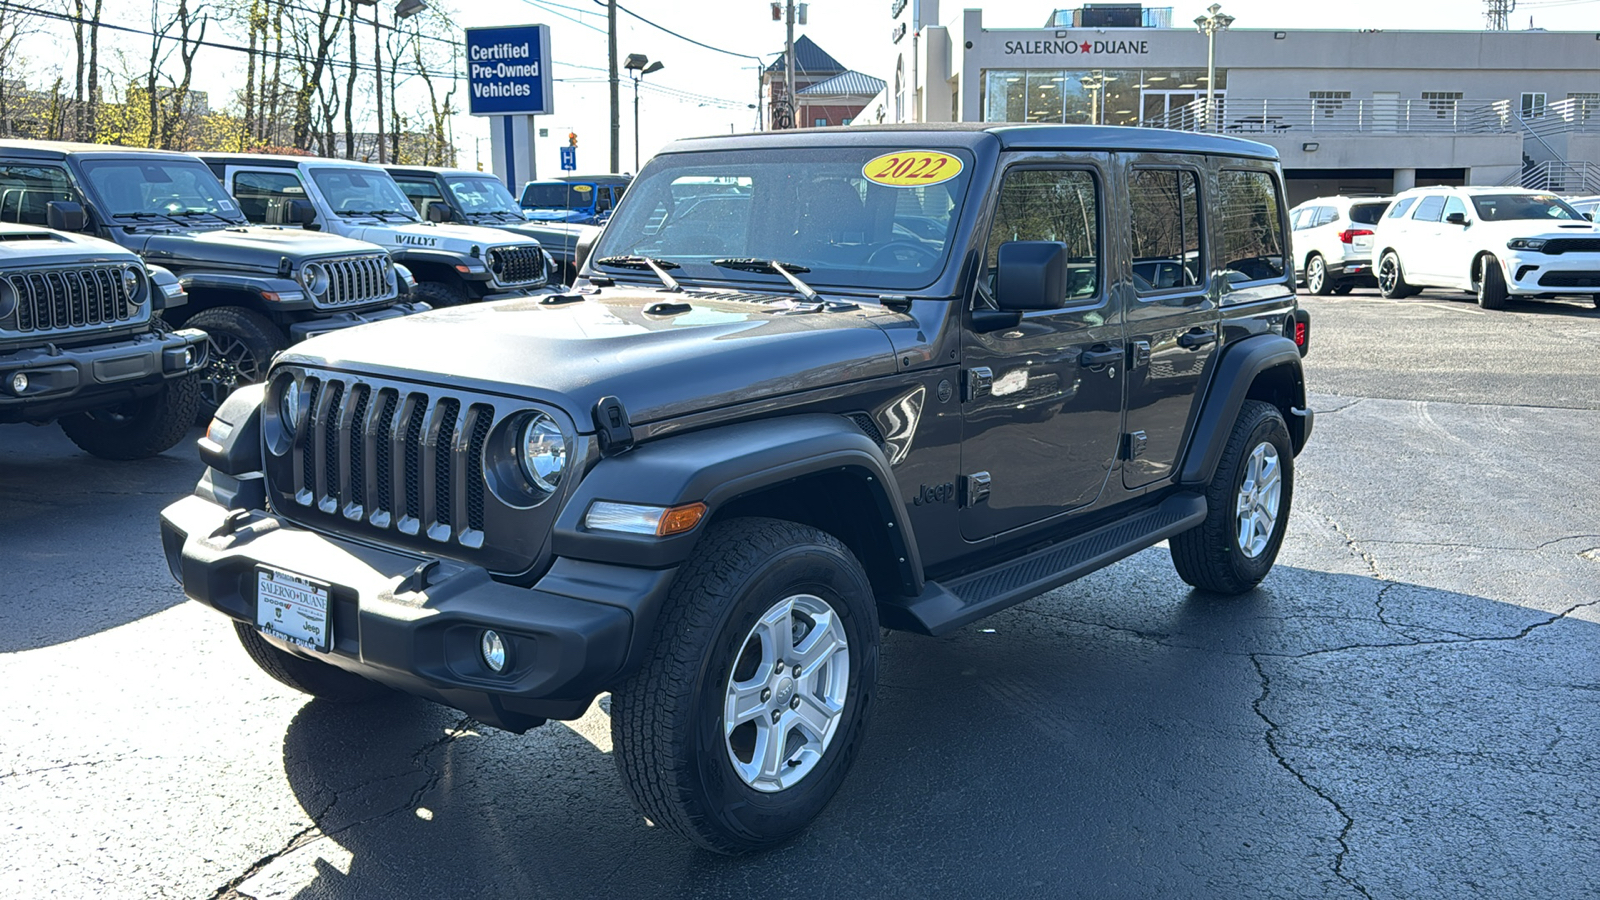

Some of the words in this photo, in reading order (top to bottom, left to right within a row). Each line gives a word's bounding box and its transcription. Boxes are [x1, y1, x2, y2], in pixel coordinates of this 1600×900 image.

[471, 43, 529, 60] Certified
[1005, 41, 1078, 54] SALERNO
[1094, 41, 1149, 54] DUANE
[472, 61, 539, 79] Pre-Owned
[473, 82, 531, 98] Vehicles
[563, 152, 573, 164] H
[874, 158, 947, 178] 2022
[395, 235, 438, 247] WILLYS
[913, 482, 955, 507] Jeep
[260, 581, 296, 600] SALERNO
[302, 621, 320, 635] Jeep
